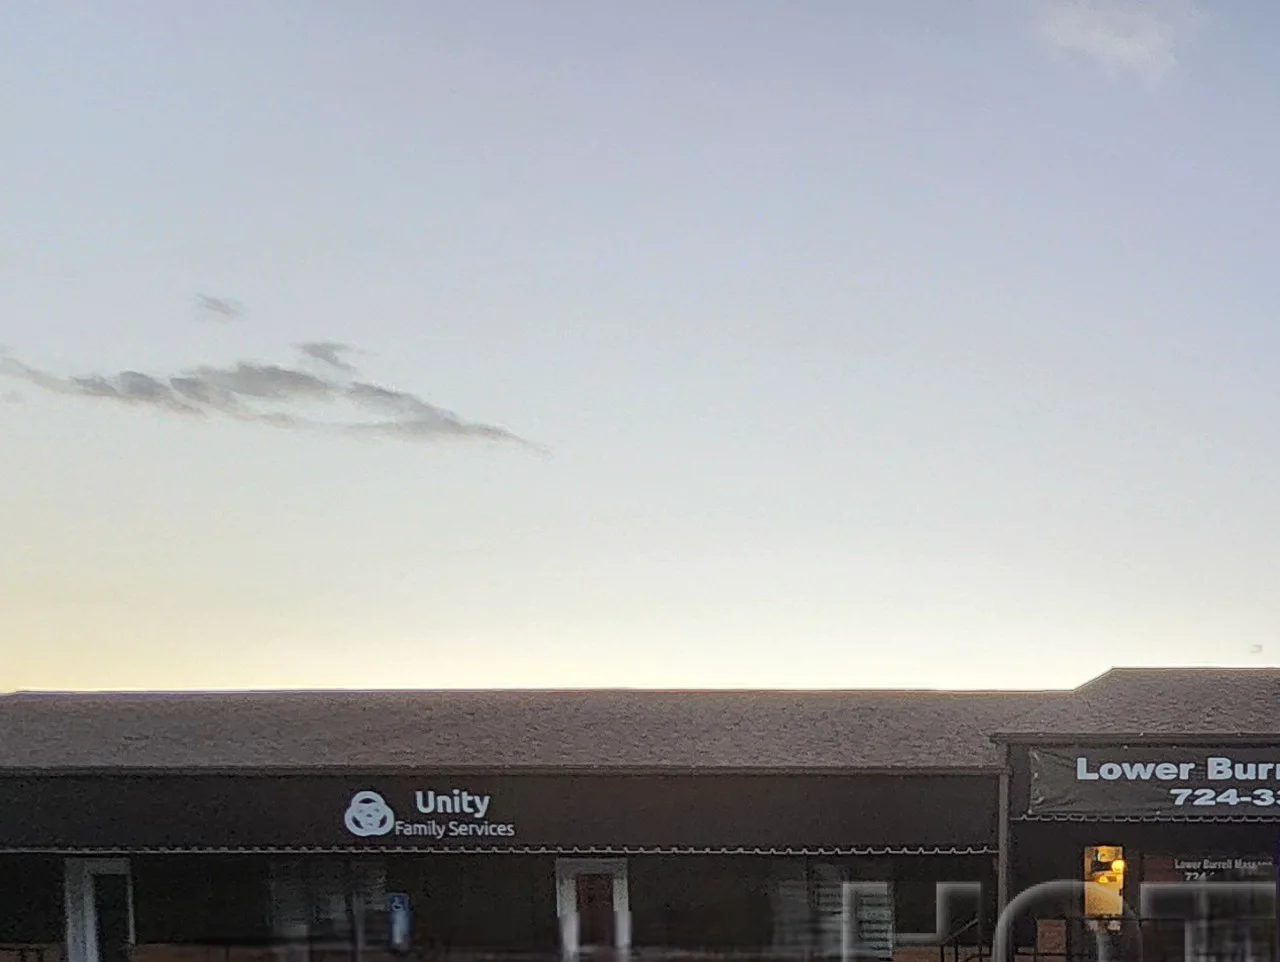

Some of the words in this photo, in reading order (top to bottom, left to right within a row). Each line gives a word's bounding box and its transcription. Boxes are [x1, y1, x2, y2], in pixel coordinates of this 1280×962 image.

[1076, 757, 1196, 781] Lower
[415, 789, 490, 818] Unity
[395, 820, 446, 839] Family
[448, 820, 515, 837] Services
[1174, 858, 1201, 869] Lower
[1203, 858, 1232, 869] Burrell
